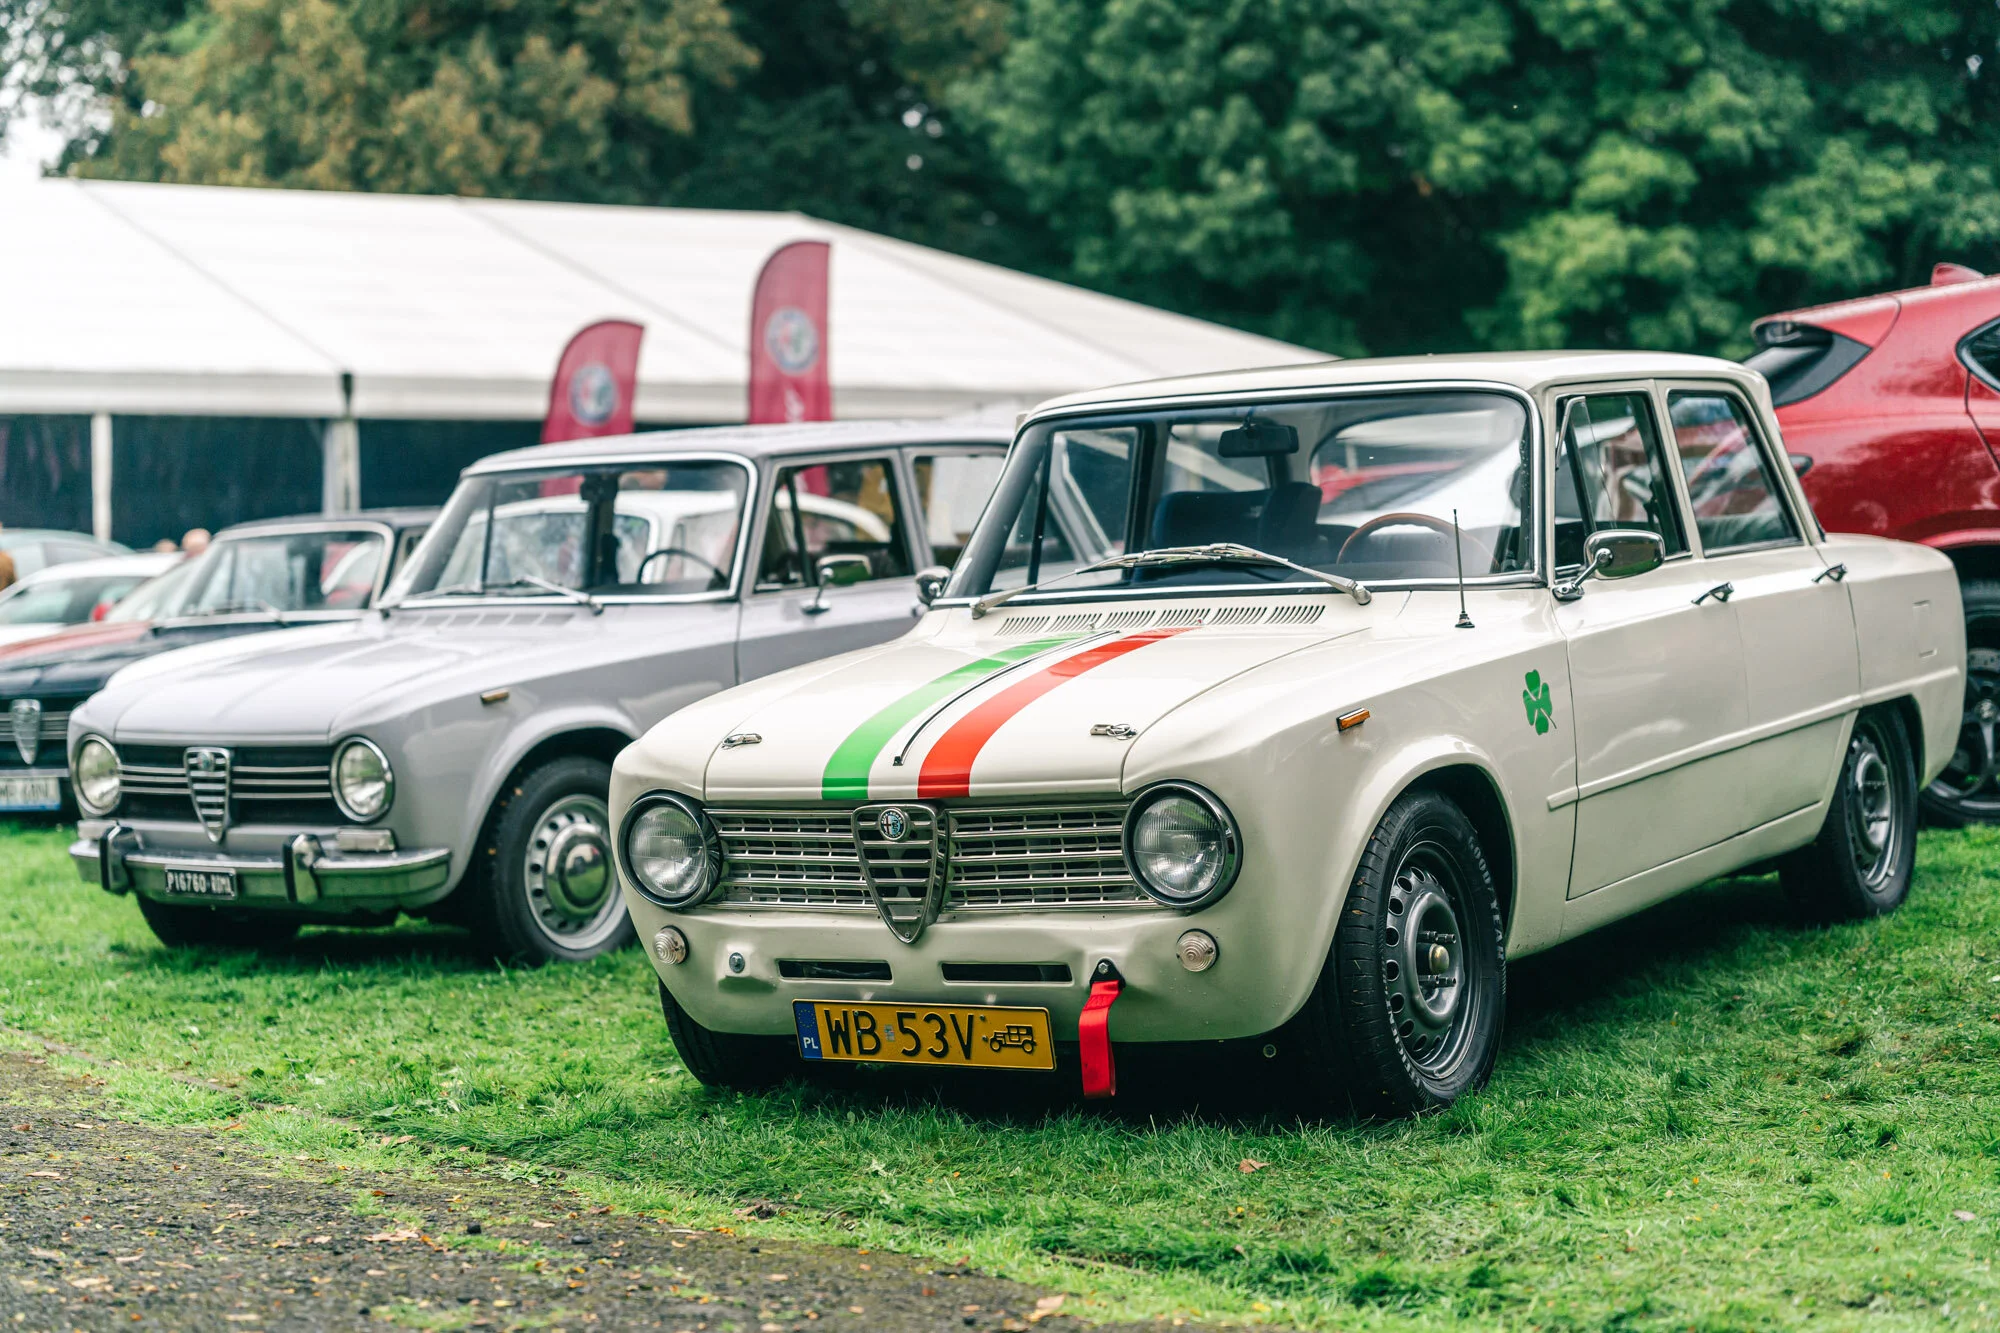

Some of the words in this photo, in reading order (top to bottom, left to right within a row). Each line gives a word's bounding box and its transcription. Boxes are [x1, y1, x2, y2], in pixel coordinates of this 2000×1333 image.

[803, 1036, 819, 1050] PL
[823, 1008, 882, 1056] WB
[896, 1010, 975, 1061] 53V
